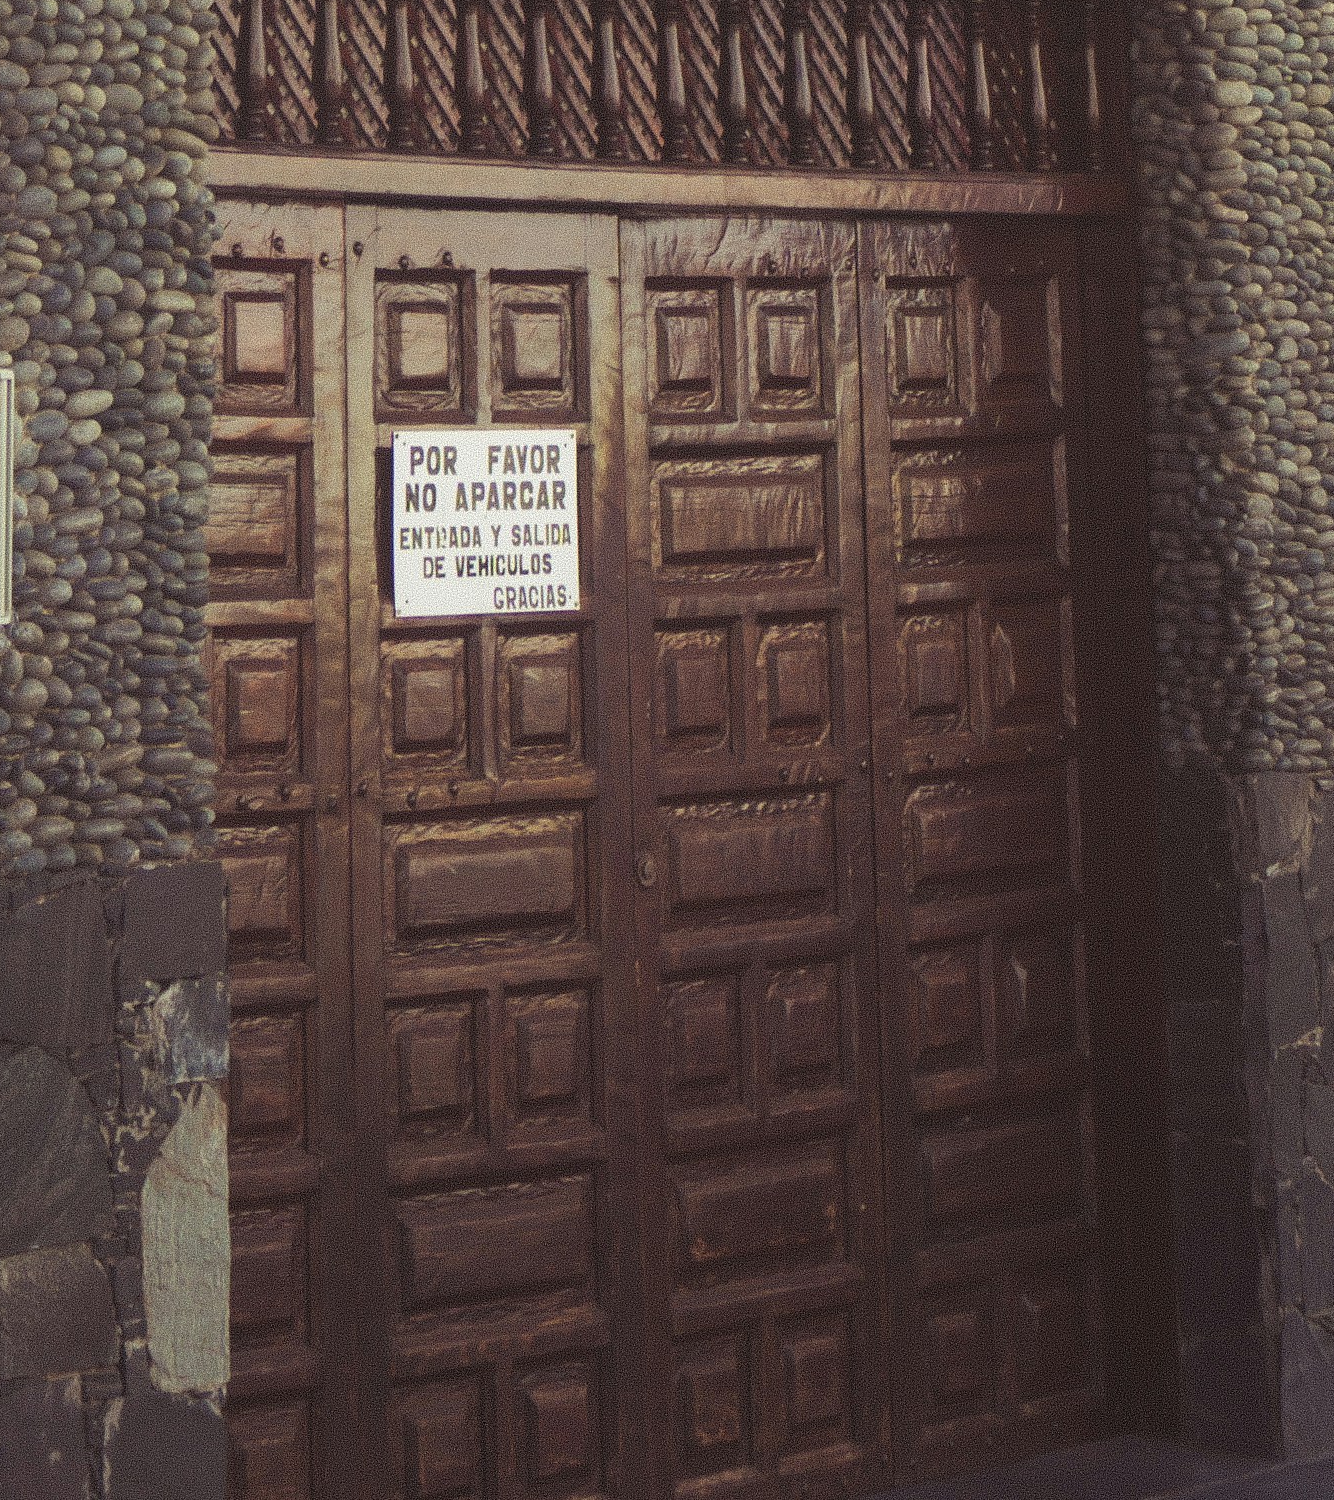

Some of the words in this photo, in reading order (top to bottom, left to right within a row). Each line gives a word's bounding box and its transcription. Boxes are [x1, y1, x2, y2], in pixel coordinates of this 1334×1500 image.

[410, 446, 458, 476] POR
[488, 444, 561, 475] FAVOR
[405, 483, 438, 513] NO
[455, 480, 567, 512] APARCAR
[400, 526, 482, 550] ENTRADA
[491, 525, 502, 547] Y
[511, 523, 572, 547] SALIDA
[423, 556, 446, 579] DE
[456, 553, 553, 578] VEHICULOS
[493, 584, 567, 610] GRACIAS
